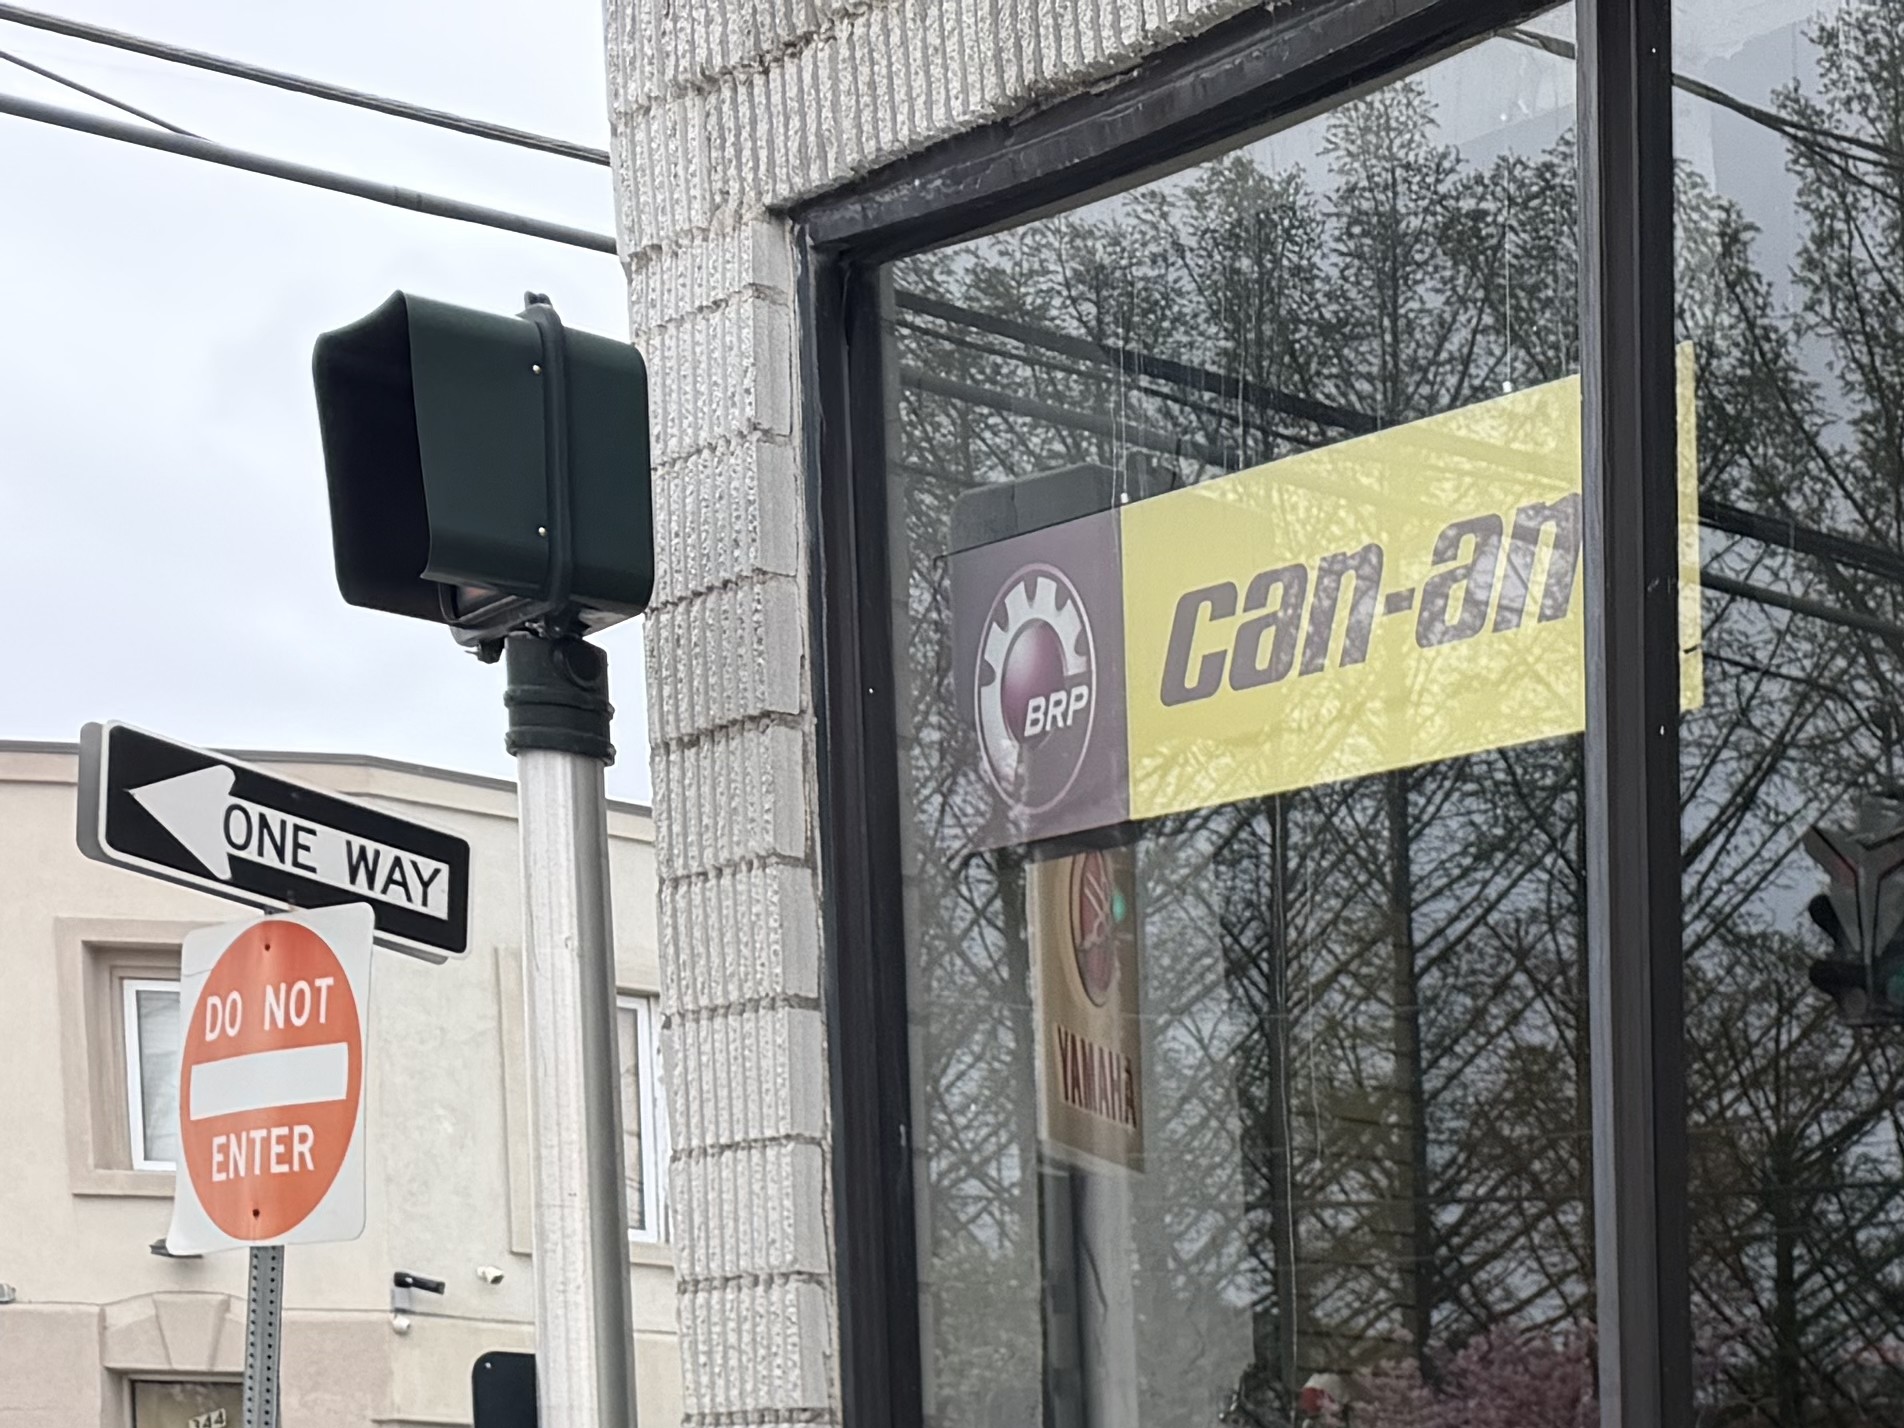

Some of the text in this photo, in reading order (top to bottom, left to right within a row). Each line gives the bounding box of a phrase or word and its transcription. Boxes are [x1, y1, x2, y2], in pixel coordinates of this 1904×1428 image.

[1023, 684, 1090, 737] BRP
[223, 803, 442, 908] ONE WAY
[204, 976, 335, 1042] DO NOT
[1056, 1026, 1137, 1129] YAMAHA
[211, 1124, 316, 1183] ENTER
